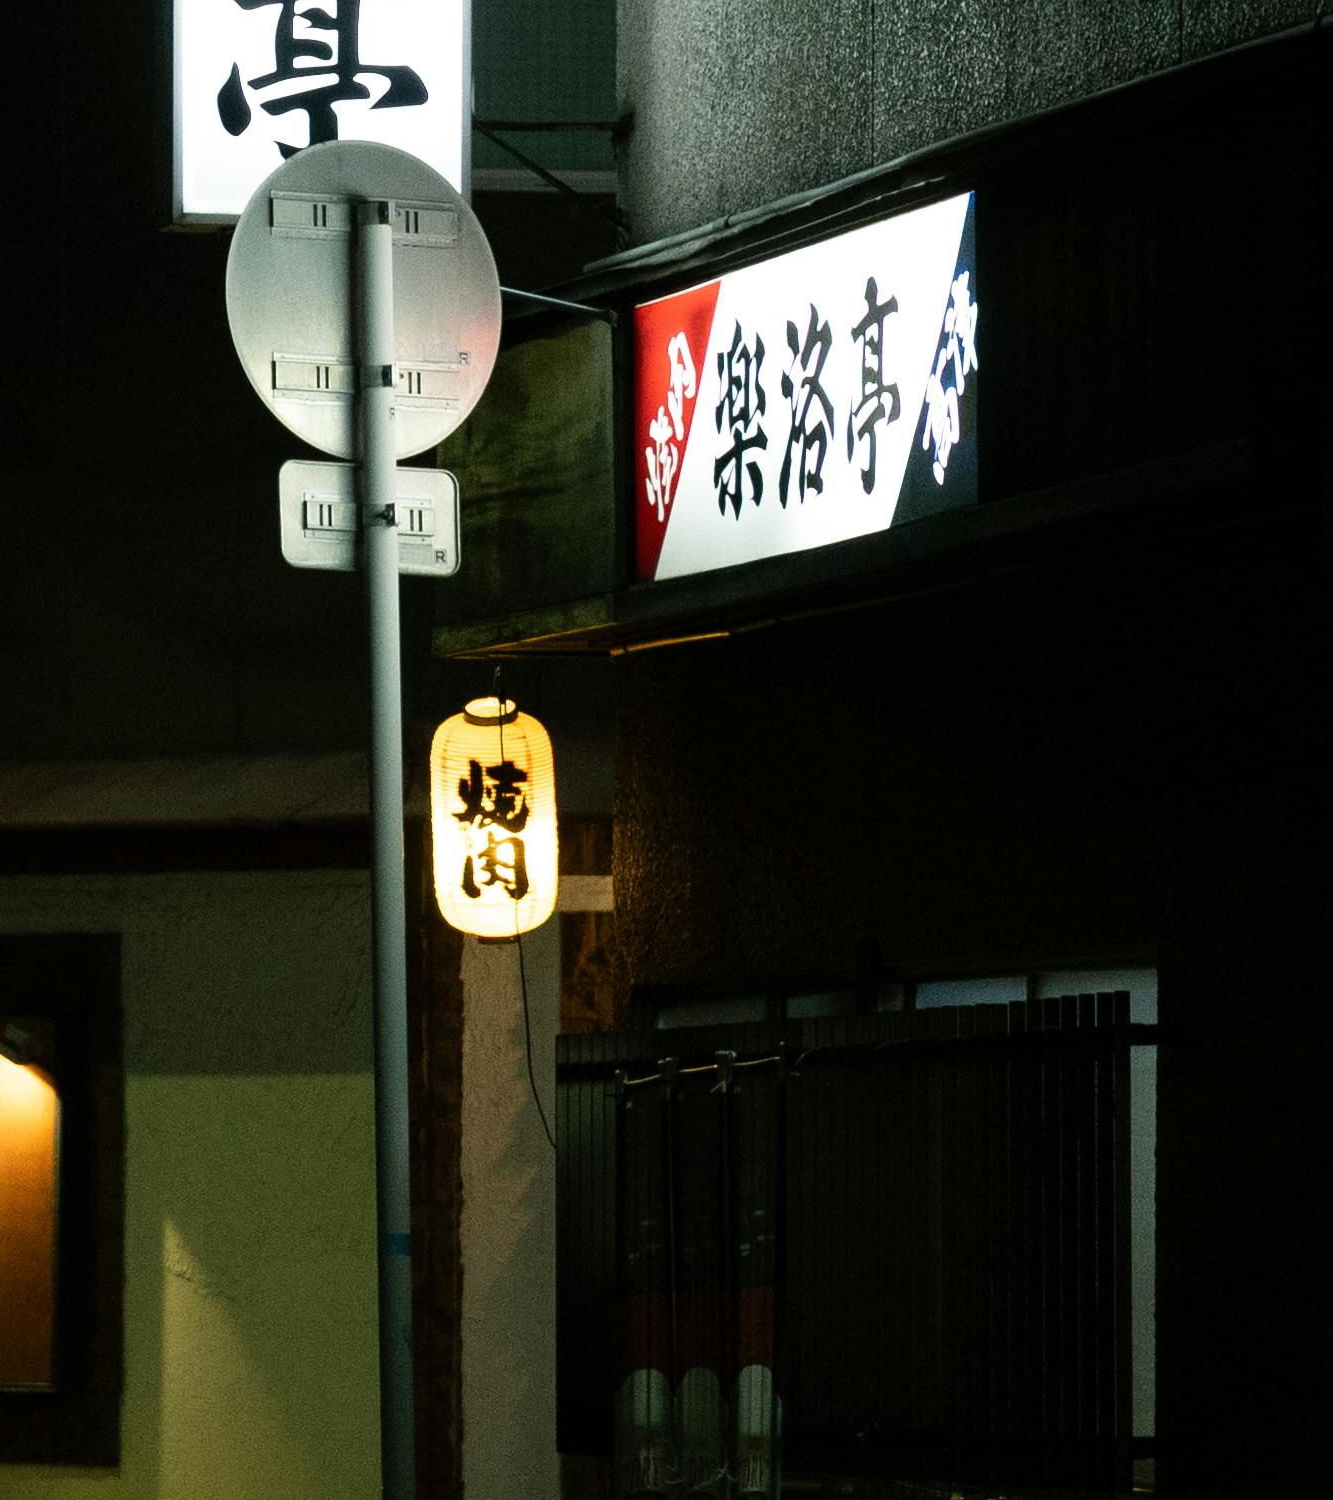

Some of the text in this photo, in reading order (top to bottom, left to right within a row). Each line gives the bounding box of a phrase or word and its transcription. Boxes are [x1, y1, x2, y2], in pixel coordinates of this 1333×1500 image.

[712, 275, 901, 522] 楽洛亭
[452, 758, 530, 900] 焼肉
